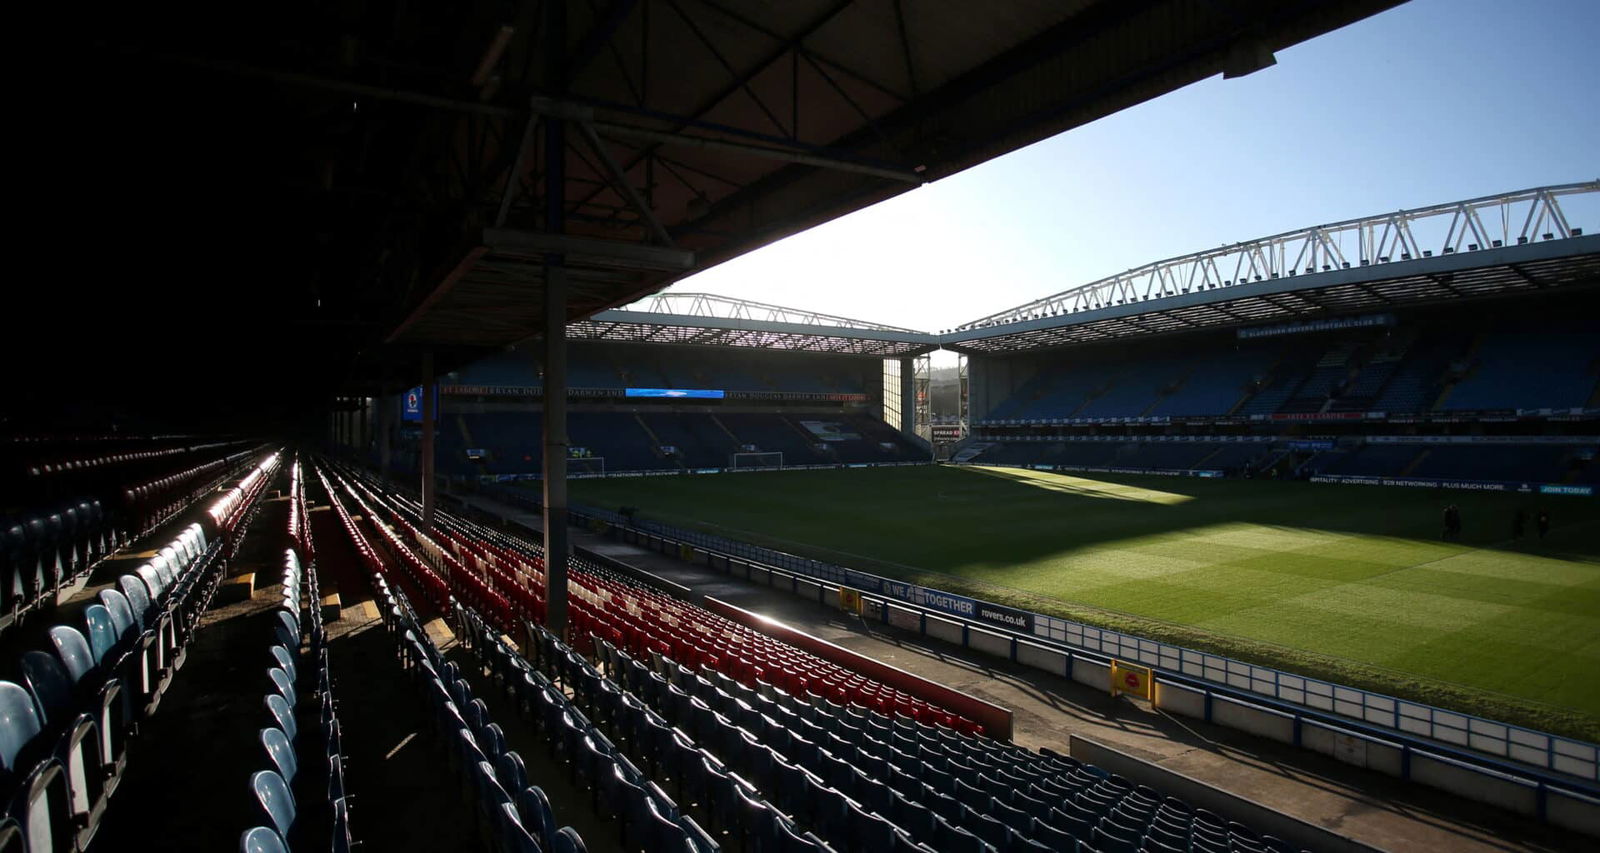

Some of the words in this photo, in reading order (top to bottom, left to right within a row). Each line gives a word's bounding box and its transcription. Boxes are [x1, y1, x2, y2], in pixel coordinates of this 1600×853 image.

[1460, 482, 1481, 490] MUCH
[1483, 483, 1504, 491] MORE
[891, 584, 905, 598] WE
[925, 592, 973, 615] TOGETHER
[981, 609, 1026, 628] rovers.co.uk
